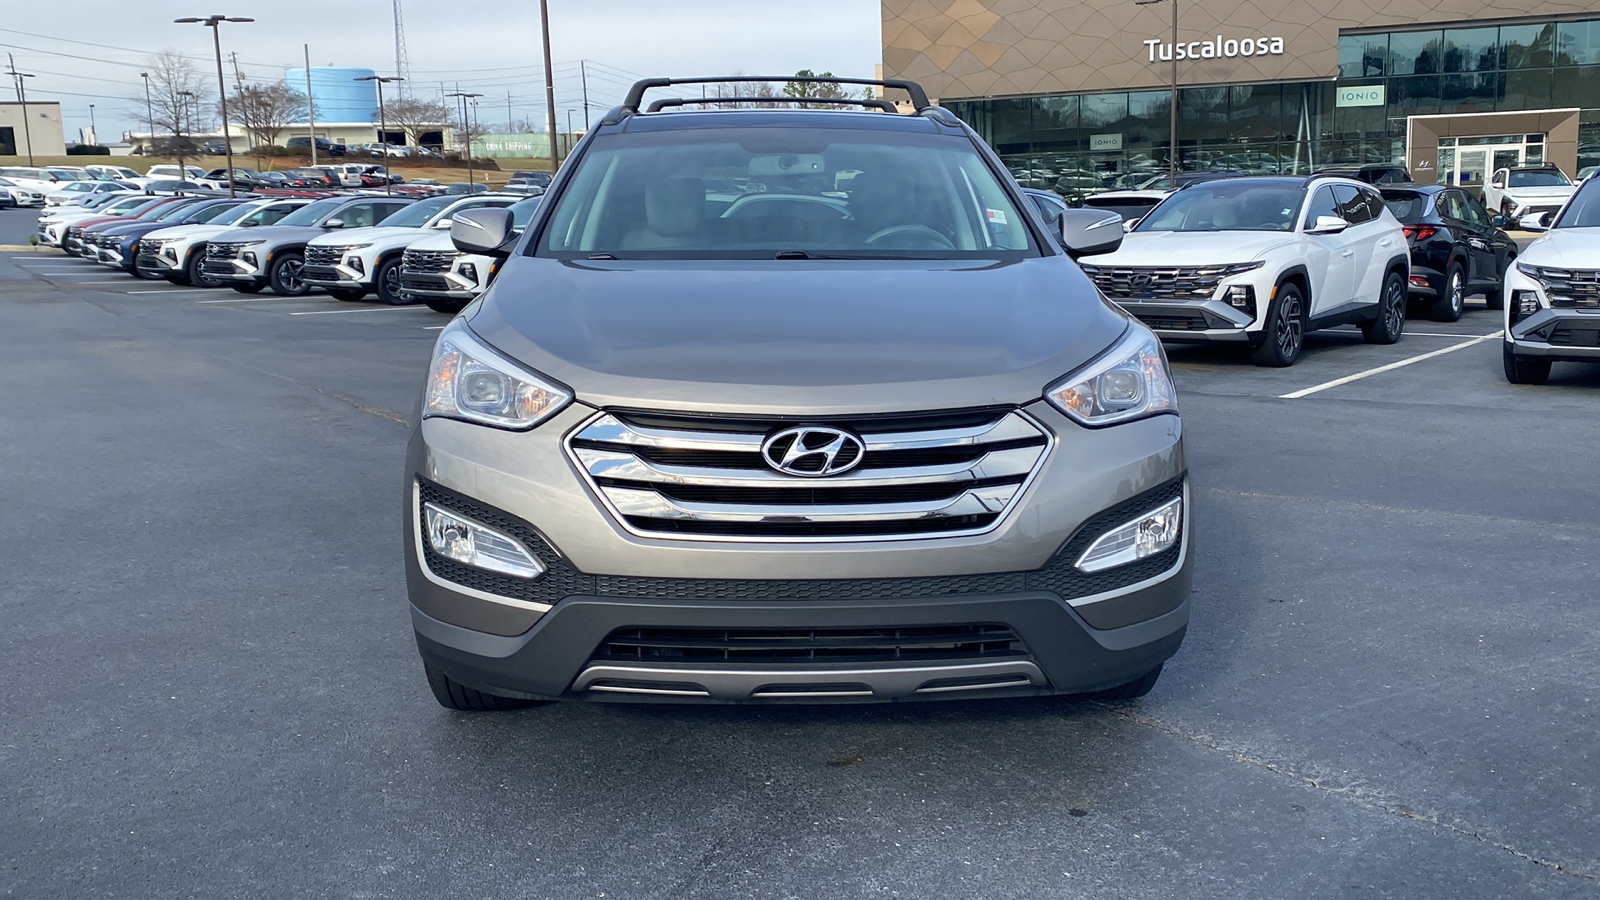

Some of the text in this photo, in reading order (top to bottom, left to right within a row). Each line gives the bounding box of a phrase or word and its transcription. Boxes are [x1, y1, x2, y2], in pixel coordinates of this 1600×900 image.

[1143, 34, 1284, 61] Tuscaloosa
[1342, 91, 1379, 101] IONIQ
[505, 141, 531, 151] SHIPPING
